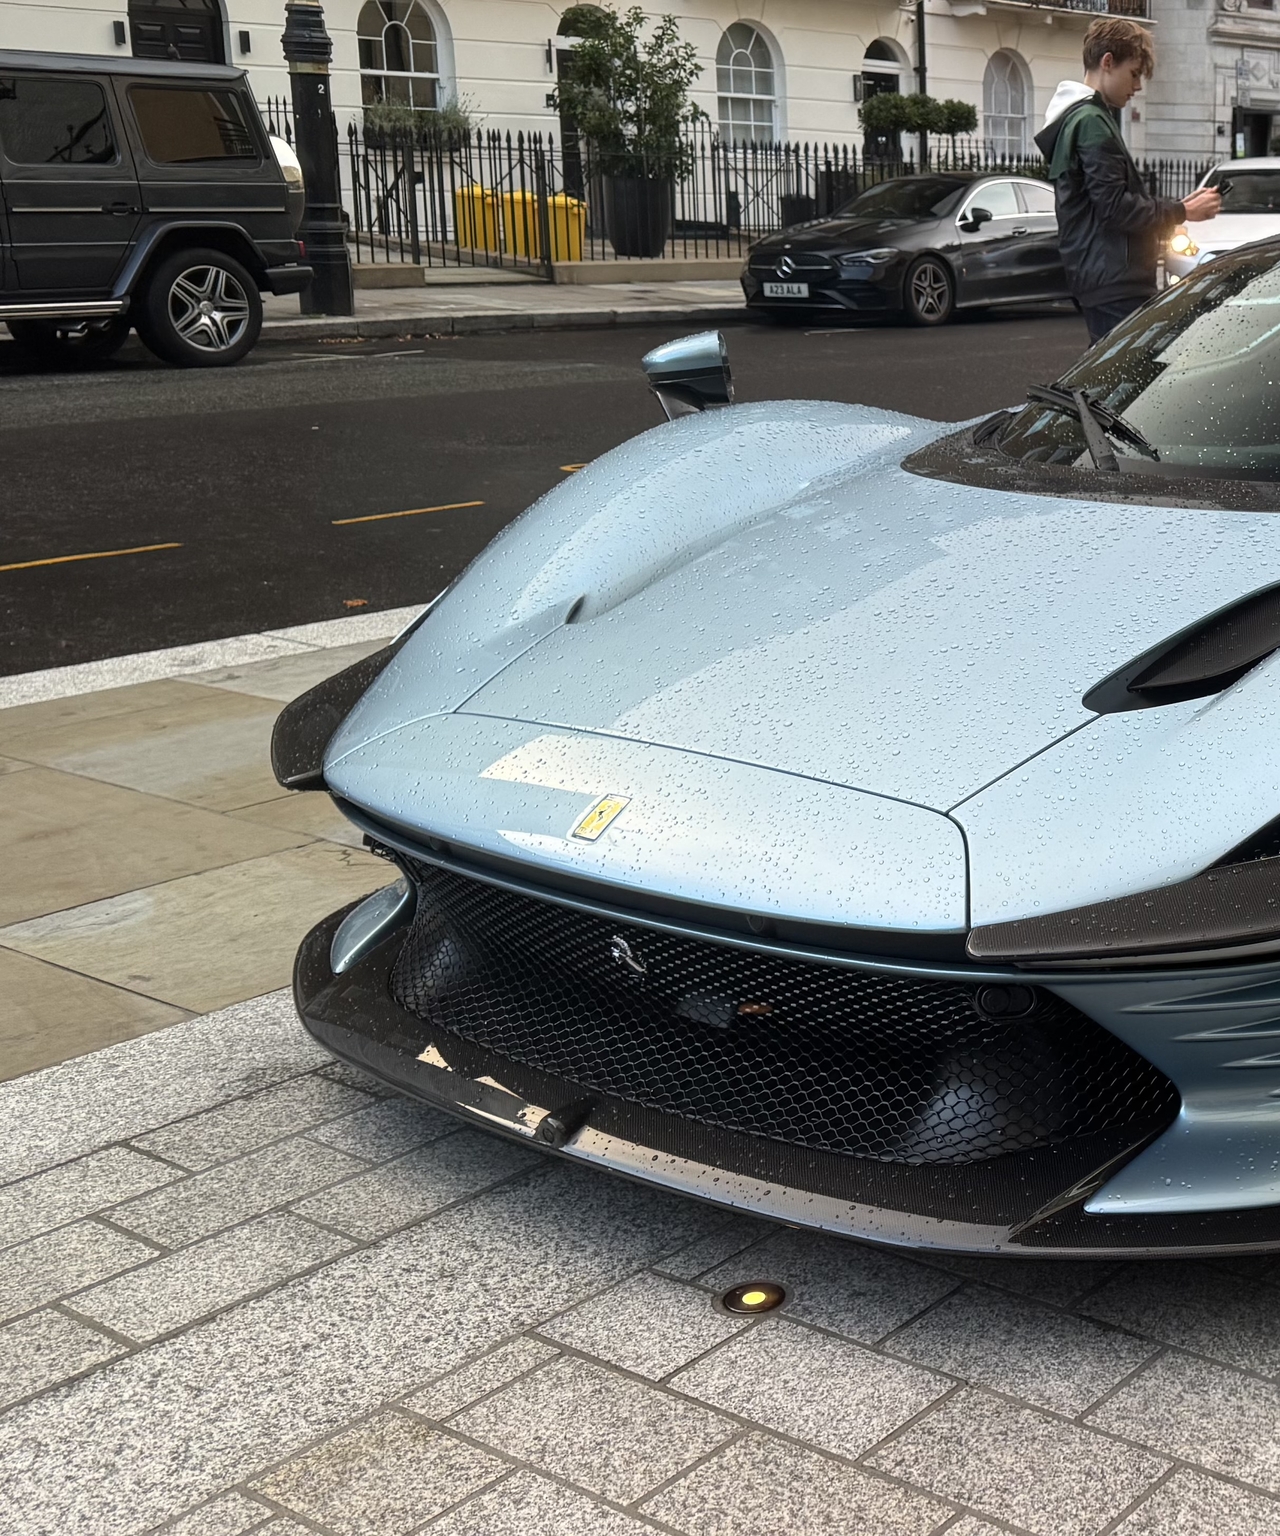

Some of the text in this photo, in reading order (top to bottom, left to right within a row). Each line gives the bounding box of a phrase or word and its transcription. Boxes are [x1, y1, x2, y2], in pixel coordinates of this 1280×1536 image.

[317, 83, 325, 94] 2
[769, 284, 803, 295] A23 ALA
